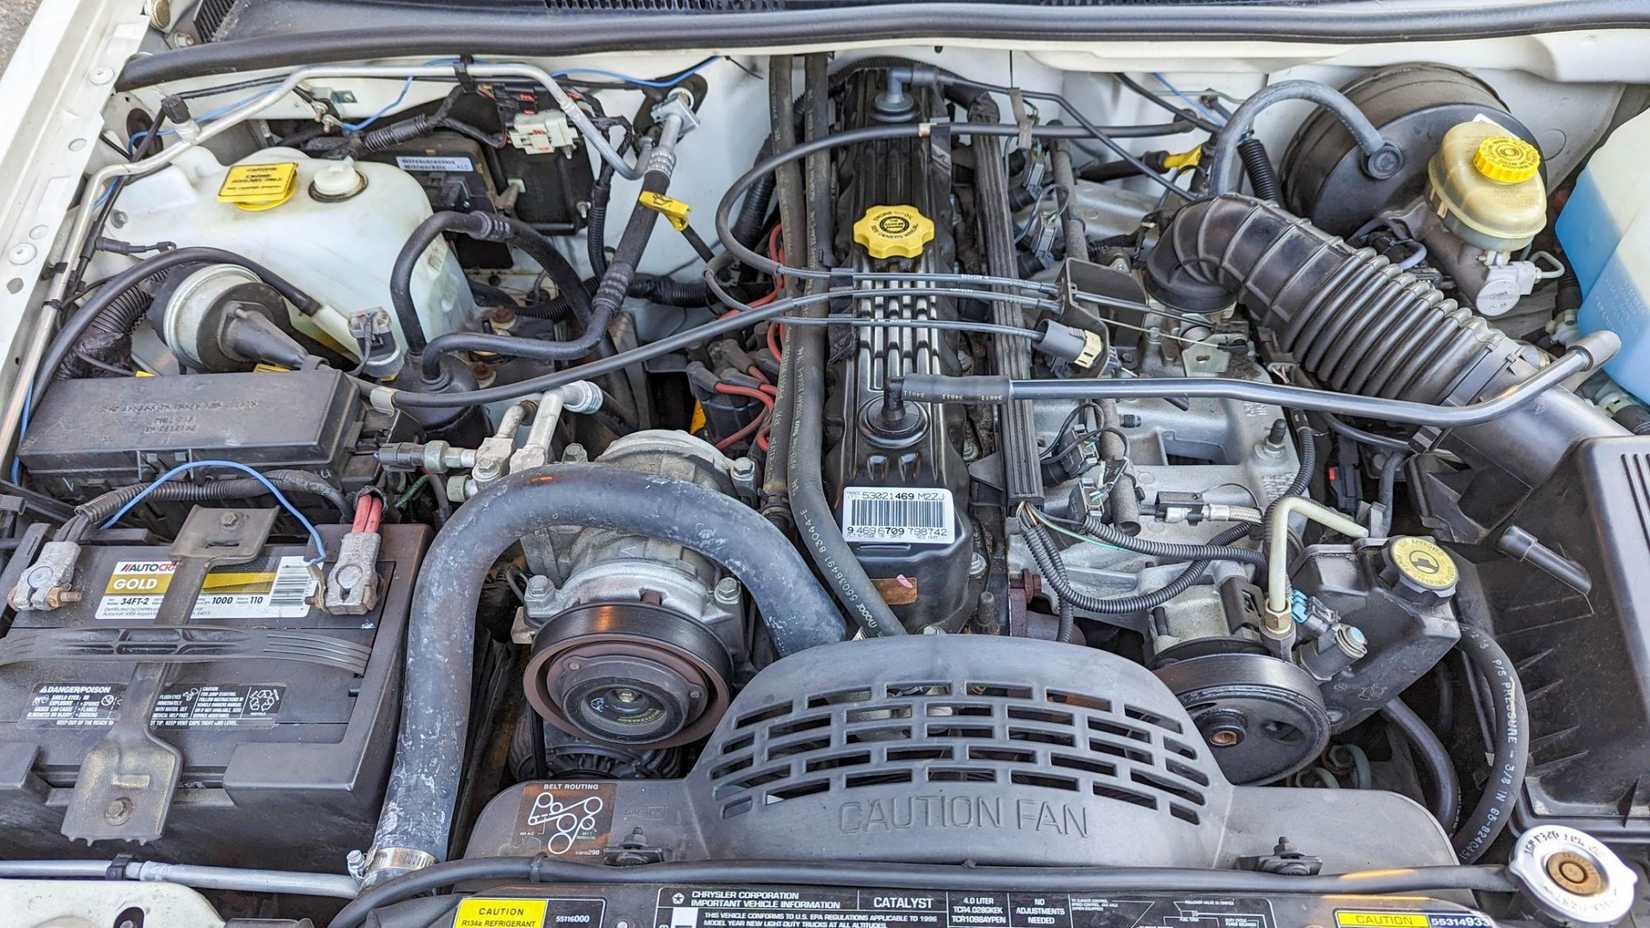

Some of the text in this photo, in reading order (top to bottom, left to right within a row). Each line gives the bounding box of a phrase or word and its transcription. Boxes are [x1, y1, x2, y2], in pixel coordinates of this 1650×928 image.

[862, 492, 914, 500] 53021469
[847, 526, 854, 534] 9
[113, 578, 157, 590] GOLD
[211, 596, 233, 605] 1000
[249, 596, 264, 605] 110
[840, 795, 1089, 838] CAUTION FAN
[738, 891, 799, 900] CORPORATION
[743, 900, 779, 908] VEHICLE
[780, 901, 841, 909] INFORMATION
[873, 897, 934, 909] CATALYST
[976, 897, 994, 905] LITER
[478, 907, 524, 915] CAUTION
[1016, 907, 1065, 915] ADJUSTMENTS
[1028, 916, 1055, 924] NEEDED
[1355, 915, 1413, 925] CAUTION
[1430, 917, 1489, 927] 55314933
